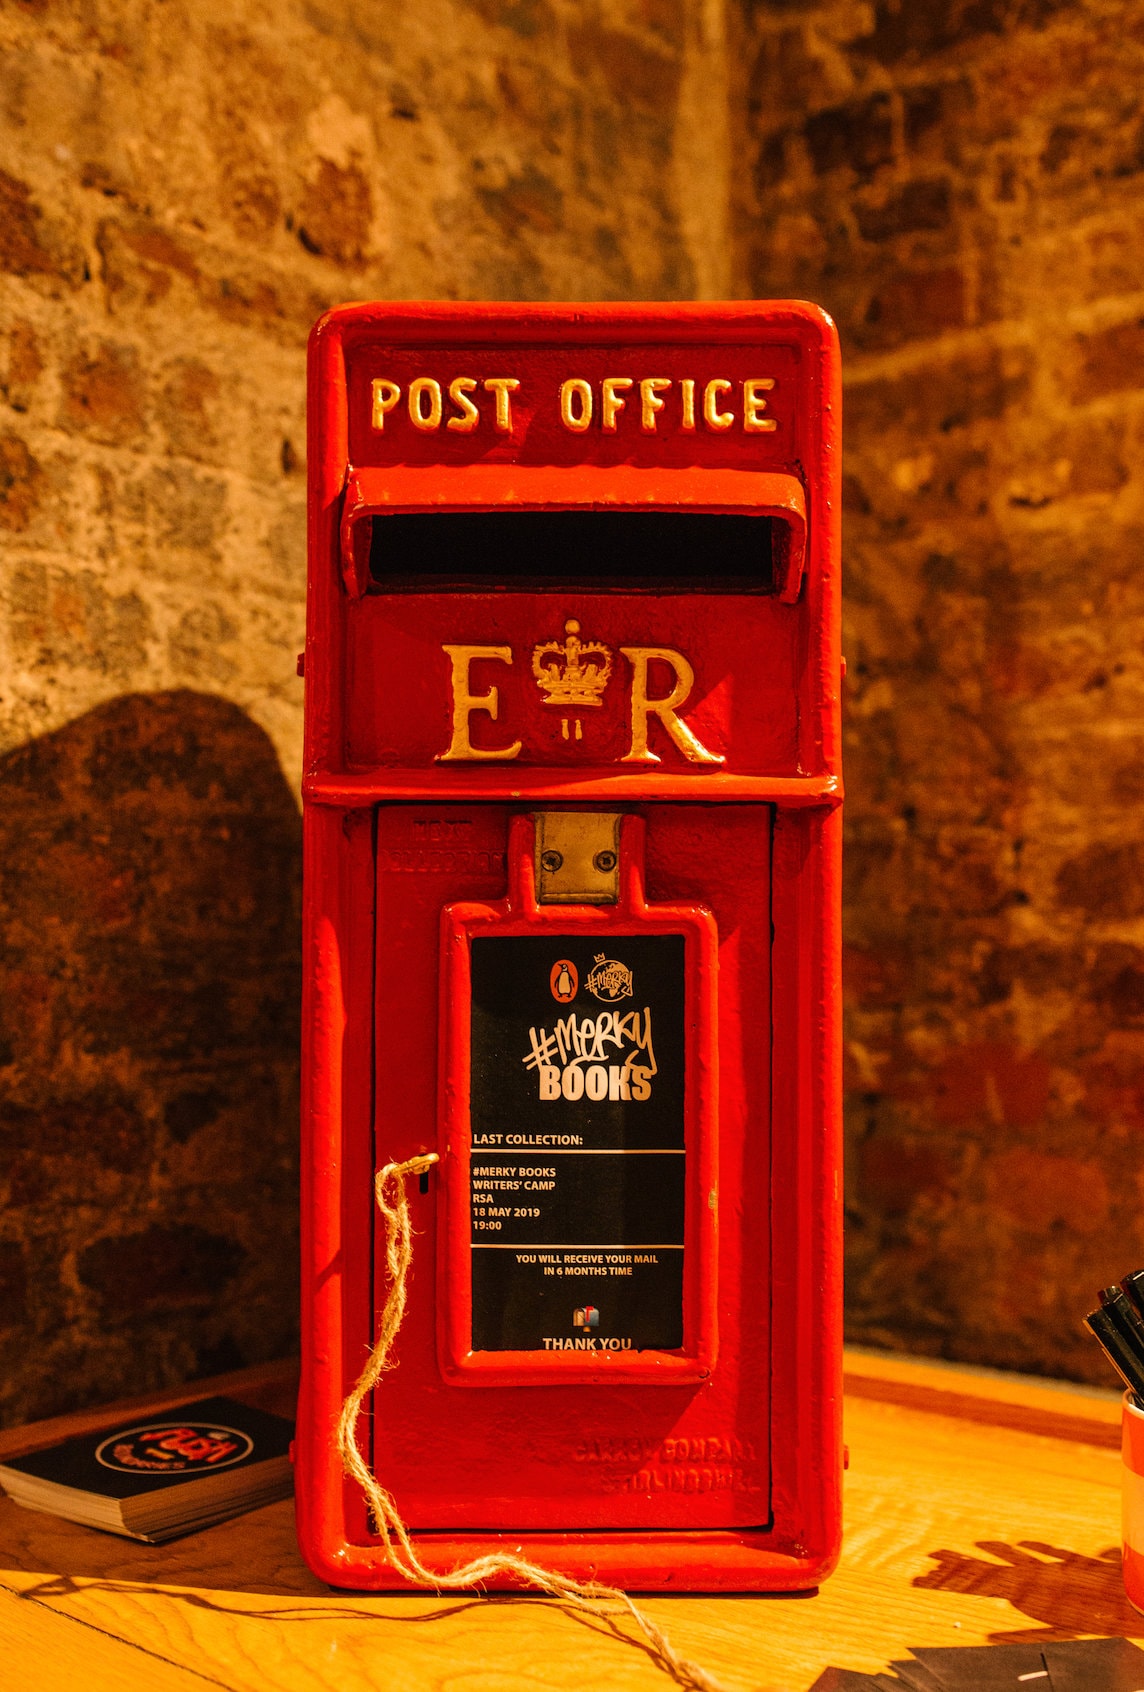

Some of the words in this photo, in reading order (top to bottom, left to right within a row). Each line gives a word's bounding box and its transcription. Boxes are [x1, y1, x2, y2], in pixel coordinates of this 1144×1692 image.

[371, 377, 520, 432] POST
[560, 378, 776, 431] OFFICE
[434, 645, 522, 760] E
[615, 648, 726, 763] R
[539, 1065, 652, 1101] BOOKS
[474, 1133, 503, 1144] LAST
[506, 1133, 583, 1145] COLLECTION:
[473, 1166, 516, 1176] #MERKY
[519, 1167, 556, 1177] BOOKS
[524, 1180, 555, 1190] CAMP
[473, 1193, 494, 1203] RSA
[473, 1207, 485, 1216] 18
[488, 1206, 511, 1216] MAY
[514, 1207, 540, 1217] 2019
[473, 1220, 501, 1230] 19:00
[516, 1254, 536, 1263] YOU
[538, 1254, 562, 1263] WILL
[564, 1254, 603, 1263] RECEIVE
[605, 1254, 632, 1263] YOUR
[634, 1254, 658, 1263] MAIL
[544, 1266, 554, 1275] IN
[557, 1266, 563, 1275] 6
[565, 1266, 607, 1275] MONTHS
[609, 1266, 632, 1275] TIME
[543, 1337, 596, 1350] THANK
[599, 1337, 631, 1350] YOU
